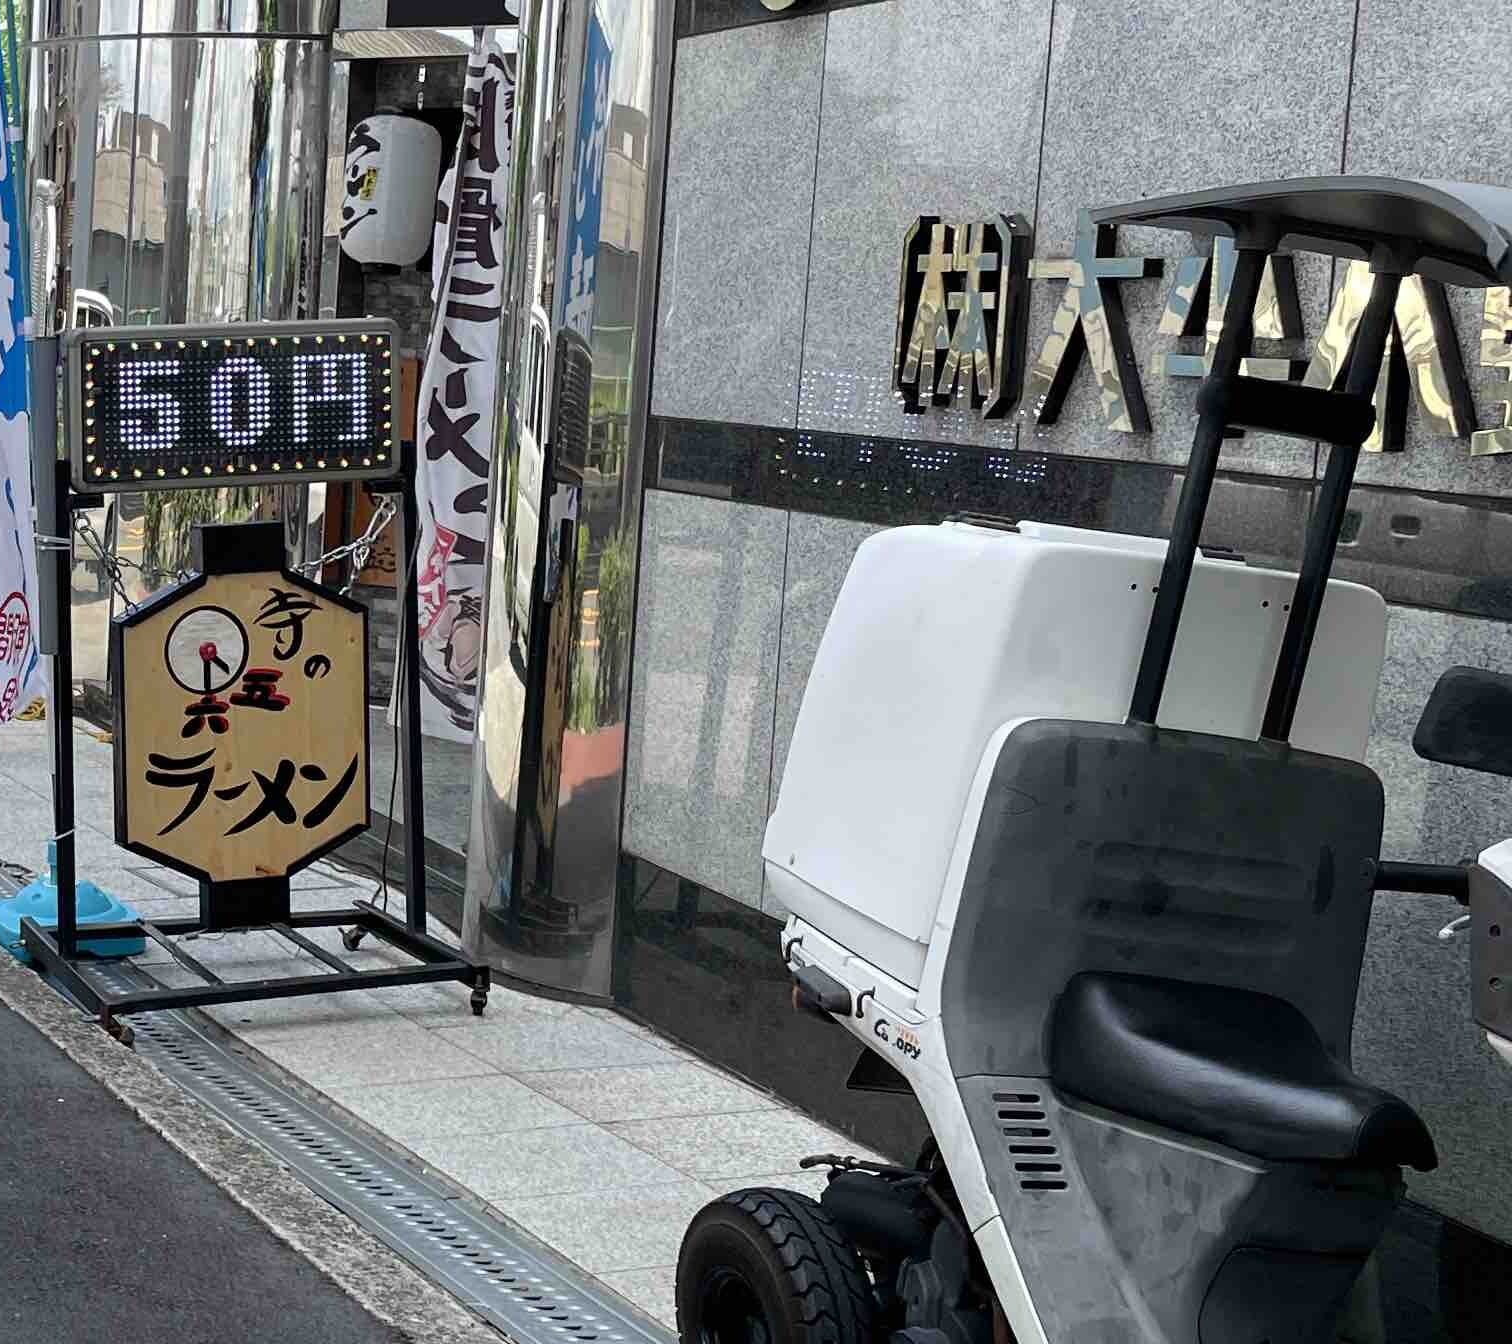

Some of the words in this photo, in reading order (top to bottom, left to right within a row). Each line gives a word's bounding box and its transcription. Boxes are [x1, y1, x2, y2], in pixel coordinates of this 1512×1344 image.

[118, 350, 368, 452] 50円
[144, 746, 360, 838] ラーメン
[873, 1018, 921, 1060] Caopy
